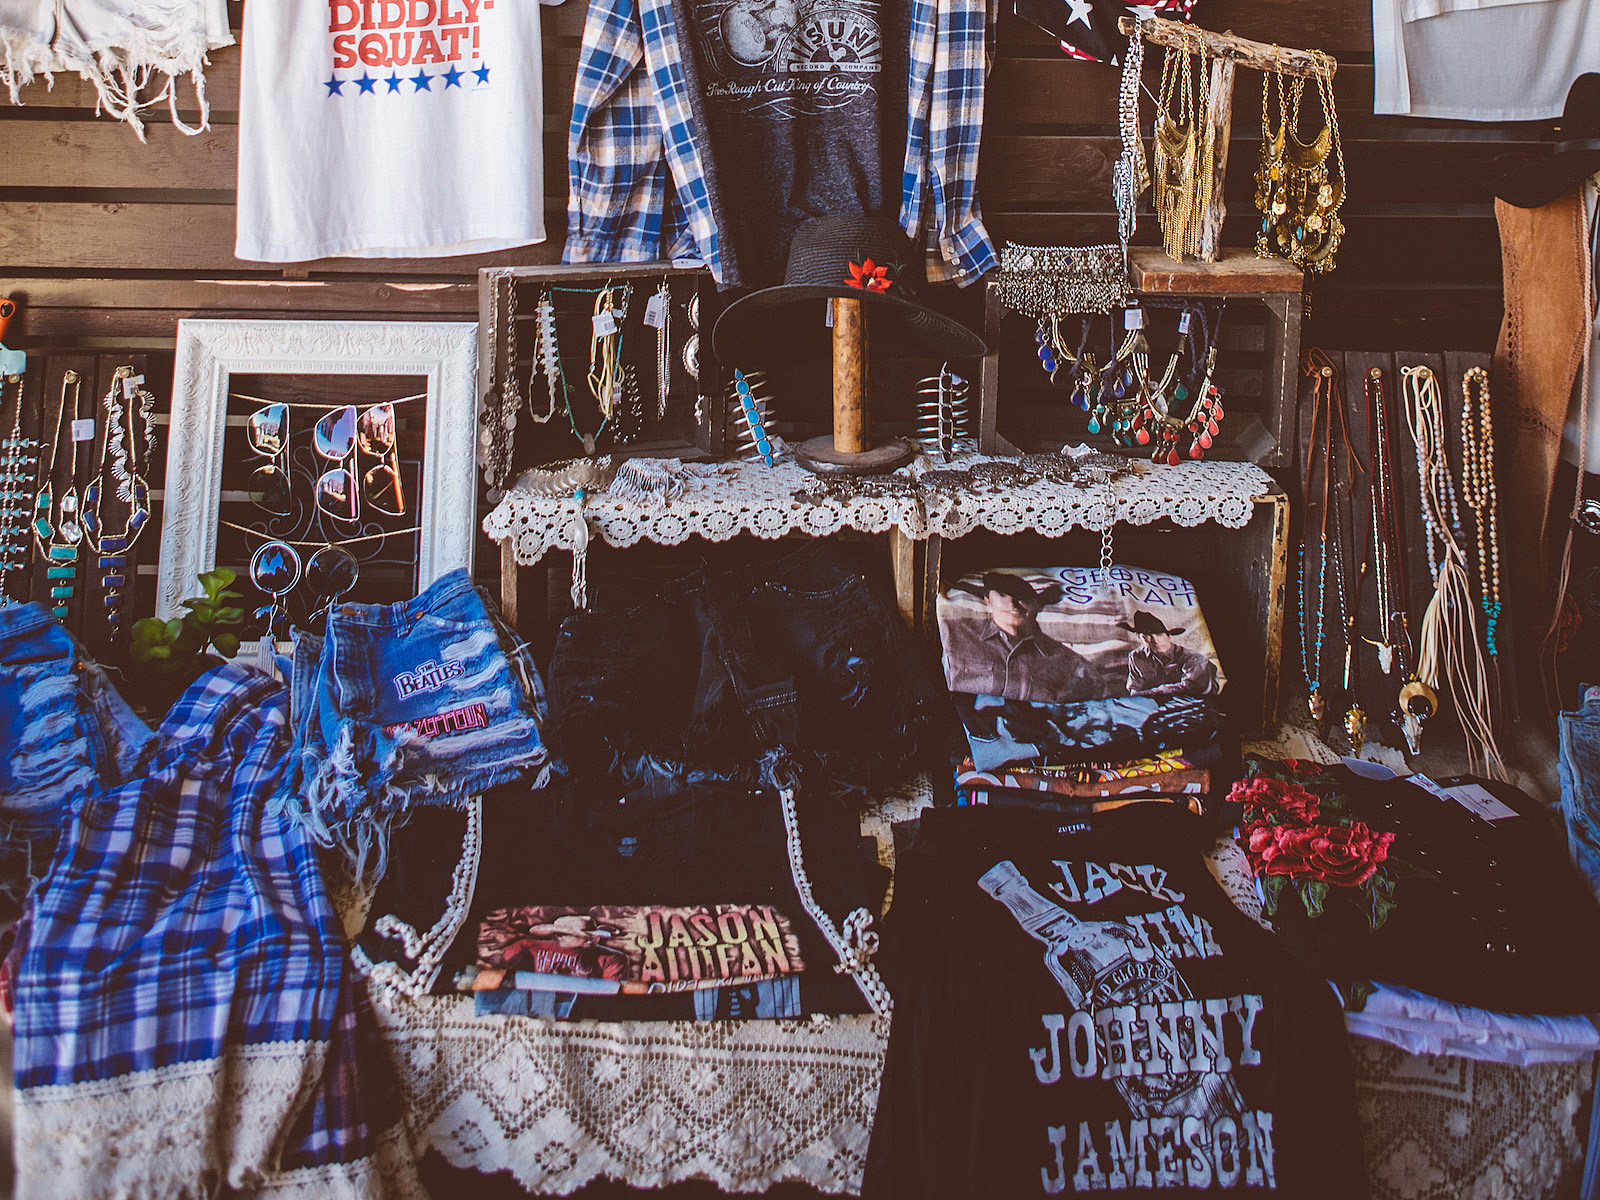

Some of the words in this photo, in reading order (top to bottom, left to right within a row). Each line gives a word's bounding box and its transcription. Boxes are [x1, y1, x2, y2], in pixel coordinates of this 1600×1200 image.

[333, 26, 480, 69] SQUAT!
[806, 21, 870, 49] SUN
[725, 80, 762, 98] Rough
[764, 78, 786, 92] Cut
[813, 77, 828, 94] of
[827, 77, 872, 95] Country
[396, 662, 462, 696] BEATLES
[1048, 860, 1186, 905] JACK
[637, 907, 781, 948] JASON
[1124, 904, 1223, 962] JIM
[1029, 994, 1264, 1085] JOHNNY
[1040, 1109, 1276, 1194] JAMESON
